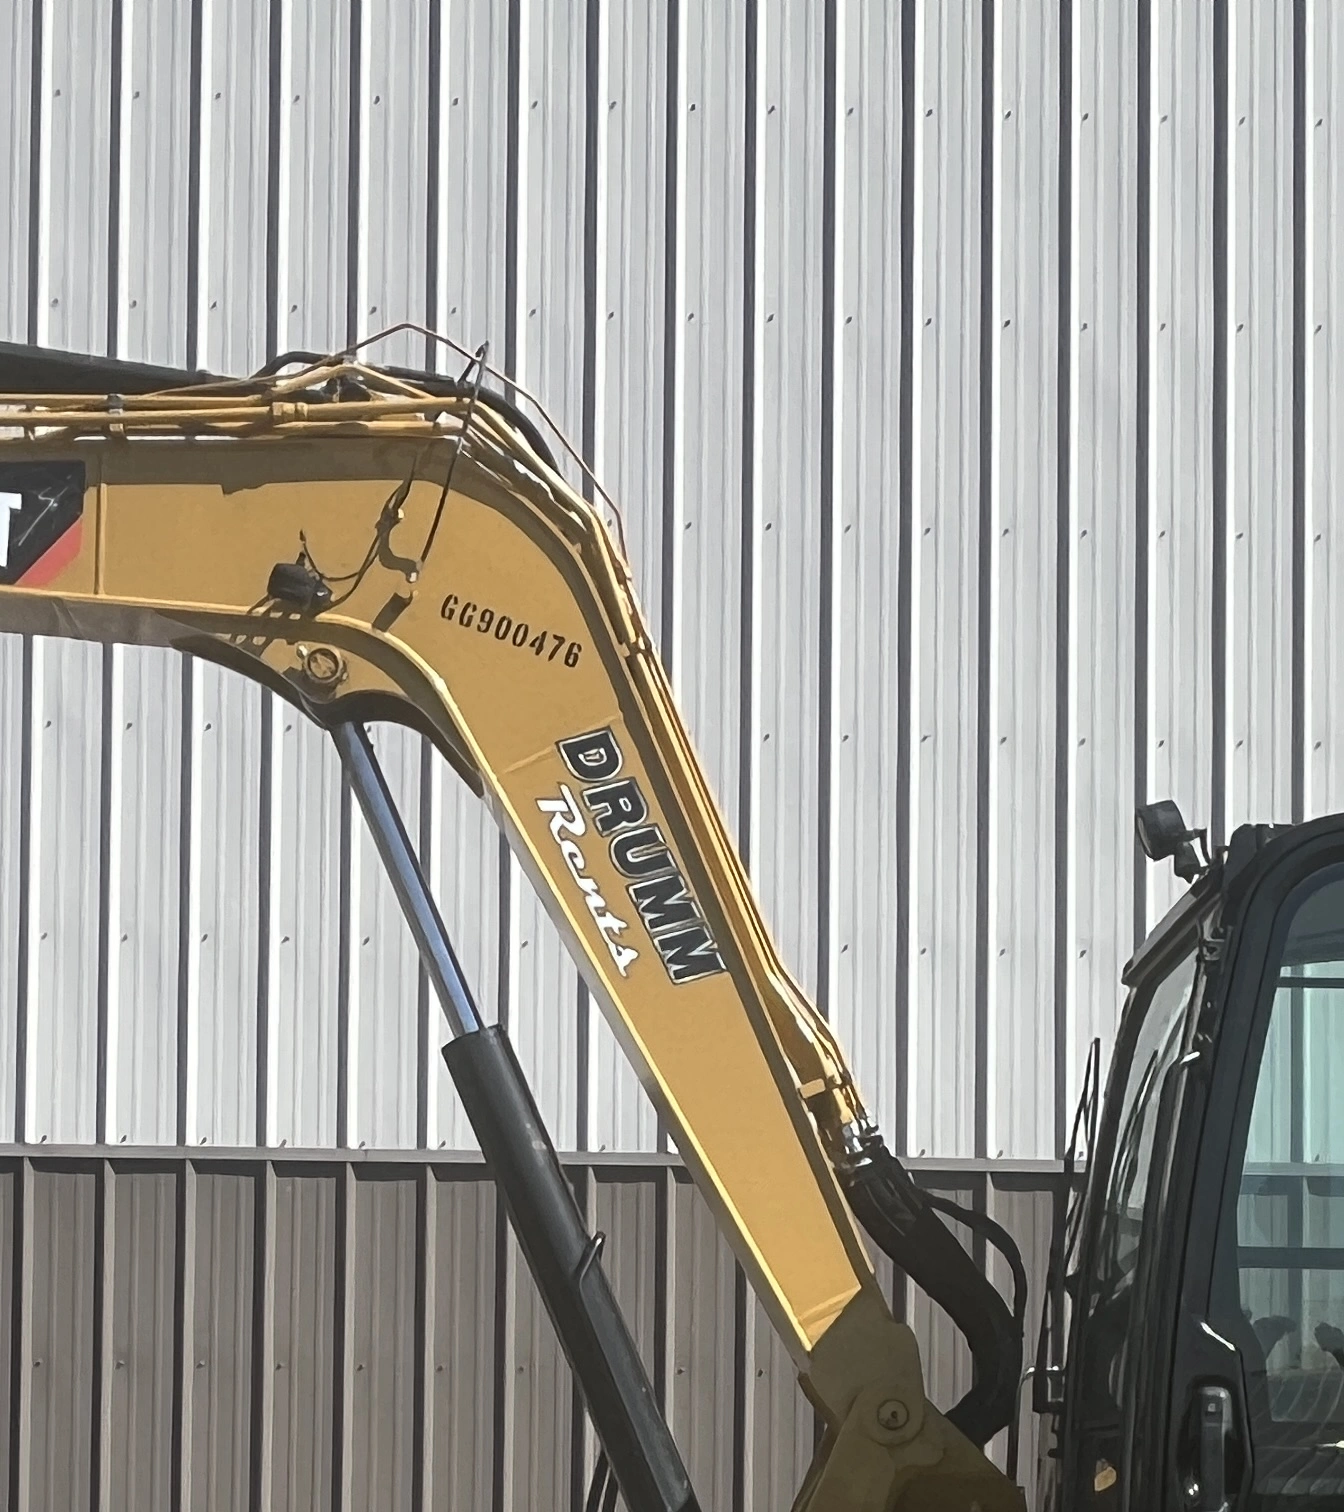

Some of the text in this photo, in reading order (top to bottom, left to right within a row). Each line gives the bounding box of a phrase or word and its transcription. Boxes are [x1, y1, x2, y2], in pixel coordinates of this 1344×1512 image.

[440, 593, 583, 669] GG900476
[535, 781, 640, 979] Rents
[555, 725, 728, 986] DRUMM
